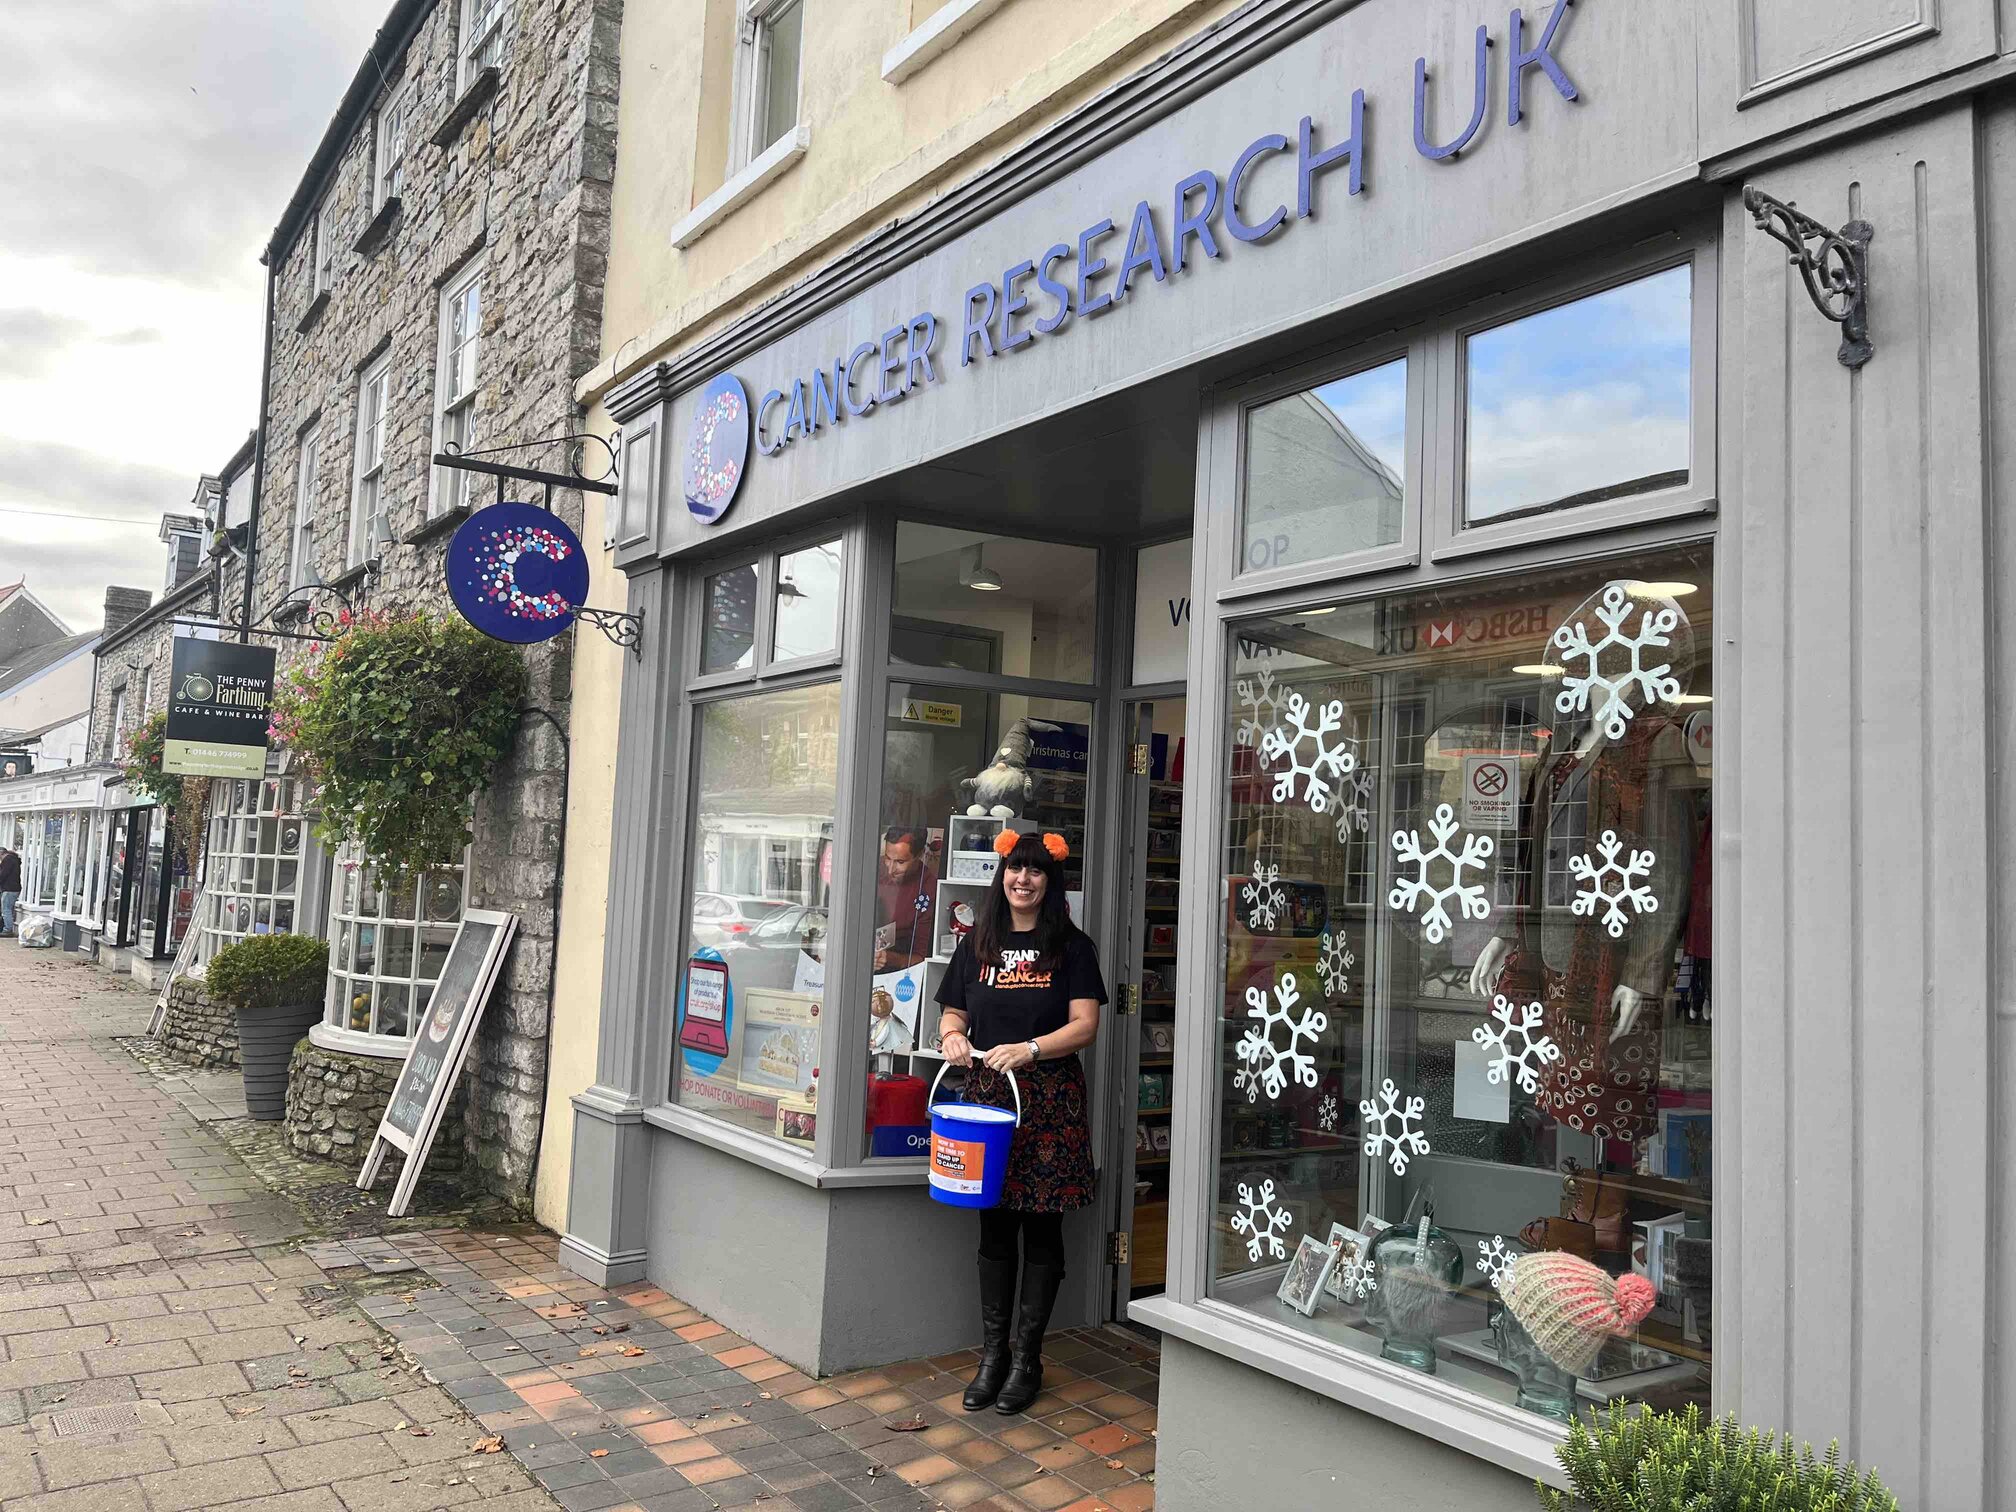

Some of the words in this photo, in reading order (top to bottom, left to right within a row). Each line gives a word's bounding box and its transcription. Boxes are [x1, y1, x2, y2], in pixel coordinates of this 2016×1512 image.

[754, 311, 935, 456] CANCER
[962, 88, 1364, 367] RESEARCH
[1413, 0, 1578, 160] UK
[216, 674, 234, 685] THE
[237, 676, 267, 688] PENNY
[215, 684, 266, 712] Farthing
[175, 706, 200, 715] CAFE
[215, 710, 241, 718] WINE
[245, 712, 264, 720] BAR
[928, 705, 954, 716] Danger
[1000, 949, 1040, 962] STAND
[996, 971, 1052, 983] CANCER
[695, 1082, 721, 1100] DONATE
[721, 1090, 733, 1104] OR
[937, 1152, 951, 1161] STAND
[942, 1160, 965, 1170] CANCER
